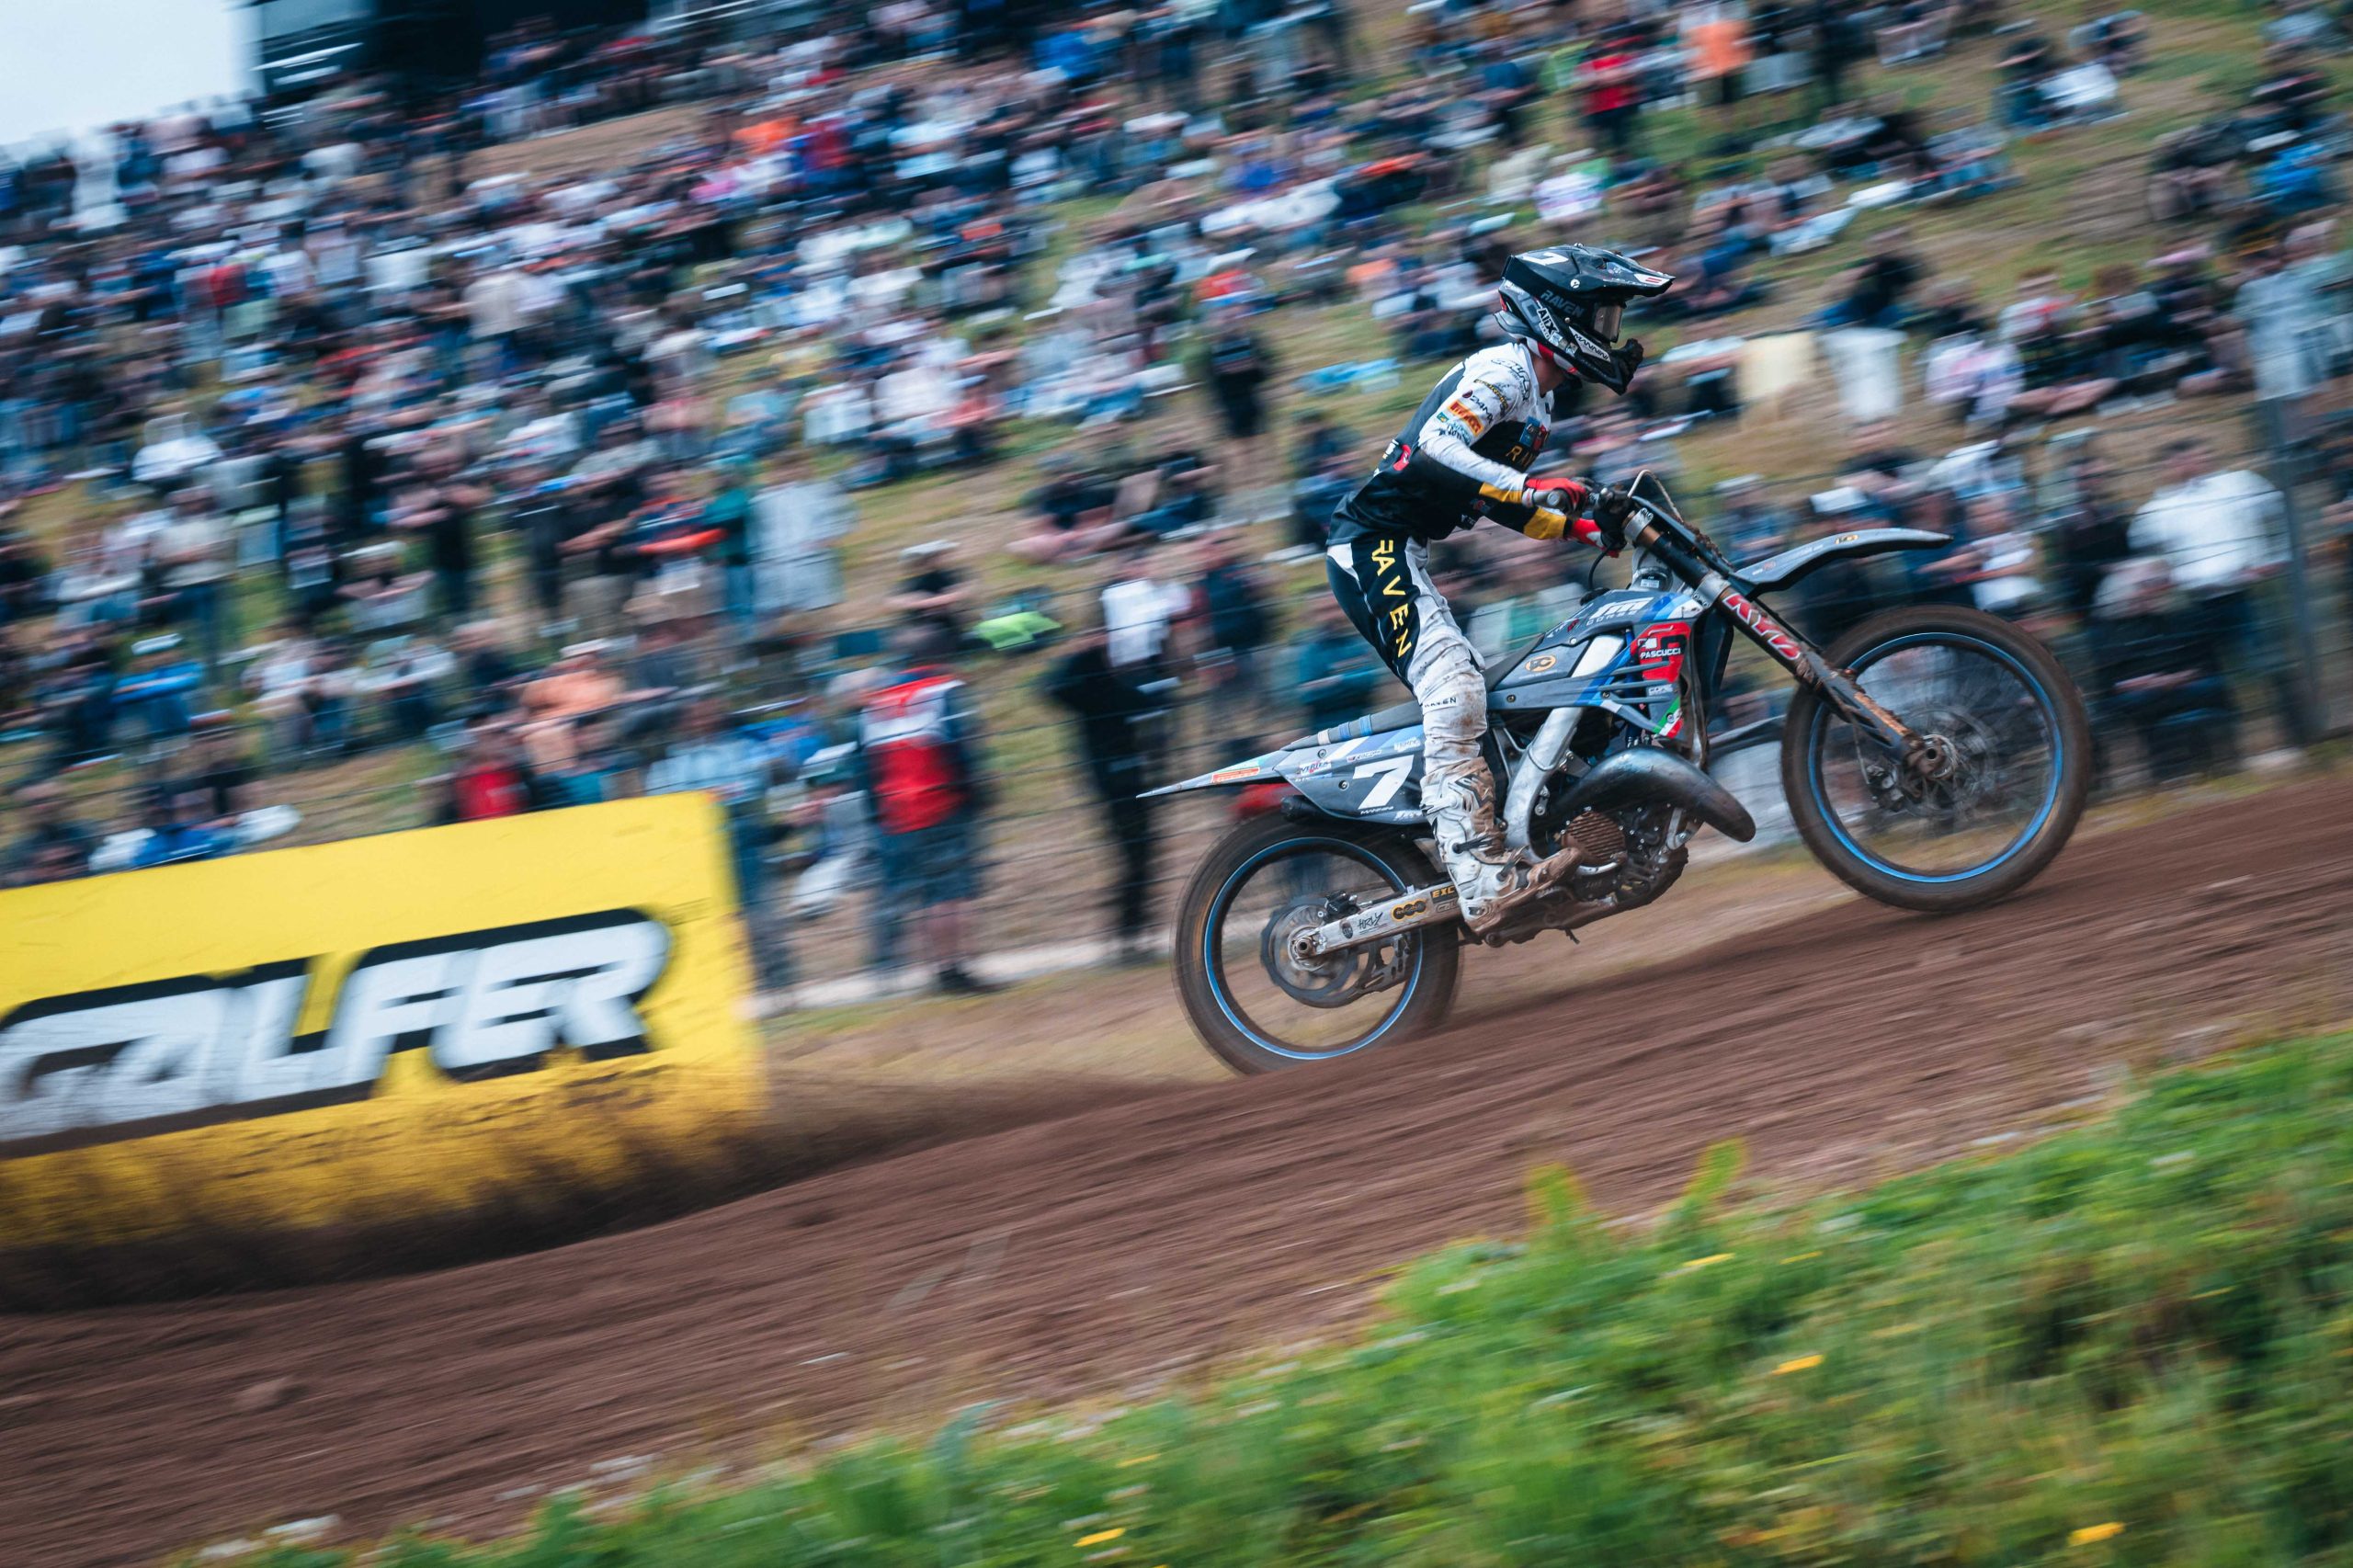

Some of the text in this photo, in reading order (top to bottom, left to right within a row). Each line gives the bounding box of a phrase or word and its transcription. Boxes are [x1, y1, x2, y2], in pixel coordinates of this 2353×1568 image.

[1540, 290, 1586, 317] RAVEN
[1573, 333, 1609, 360] MANNINI
[1371, 539, 1413, 658] RAVEN
[1721, 592, 1802, 661] KYB
[1639, 647, 1682, 660] PASCUCCI
[1352, 754, 1415, 810] 7
